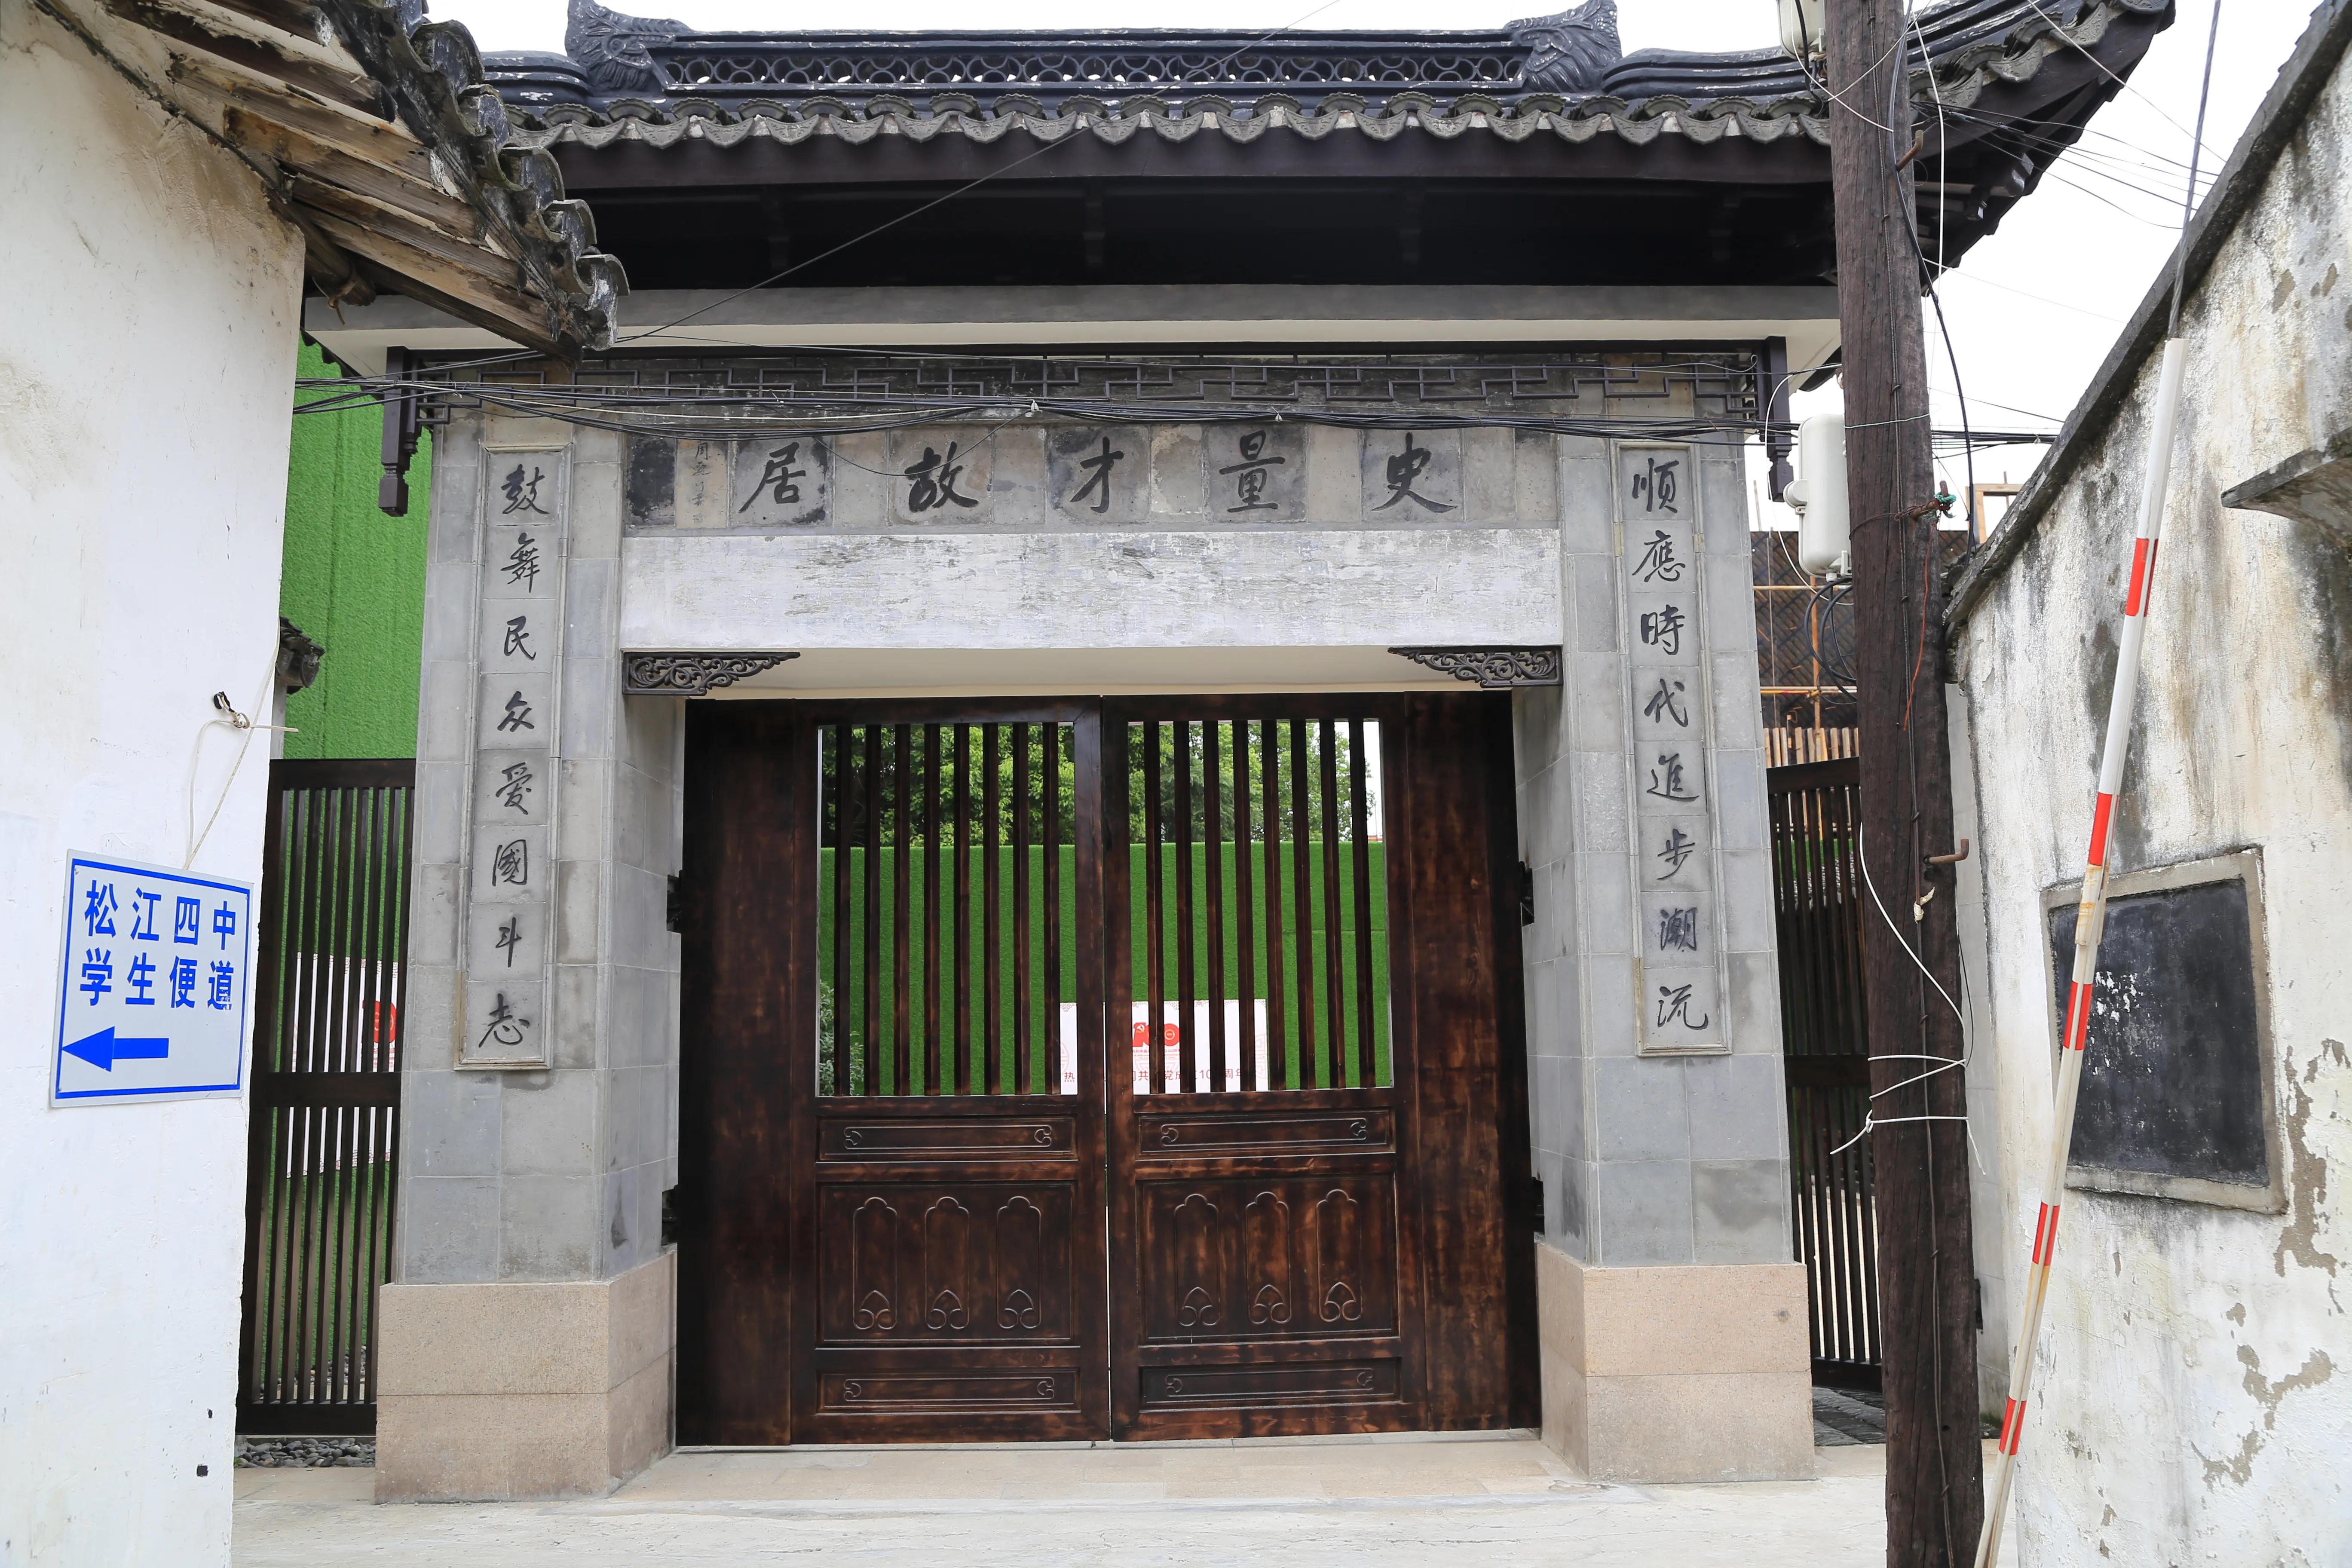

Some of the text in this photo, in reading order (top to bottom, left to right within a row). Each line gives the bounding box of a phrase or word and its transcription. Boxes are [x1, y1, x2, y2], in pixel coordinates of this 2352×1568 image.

[85, 879, 236, 950] 松江四中
[80, 947, 234, 1011] 学生便道
